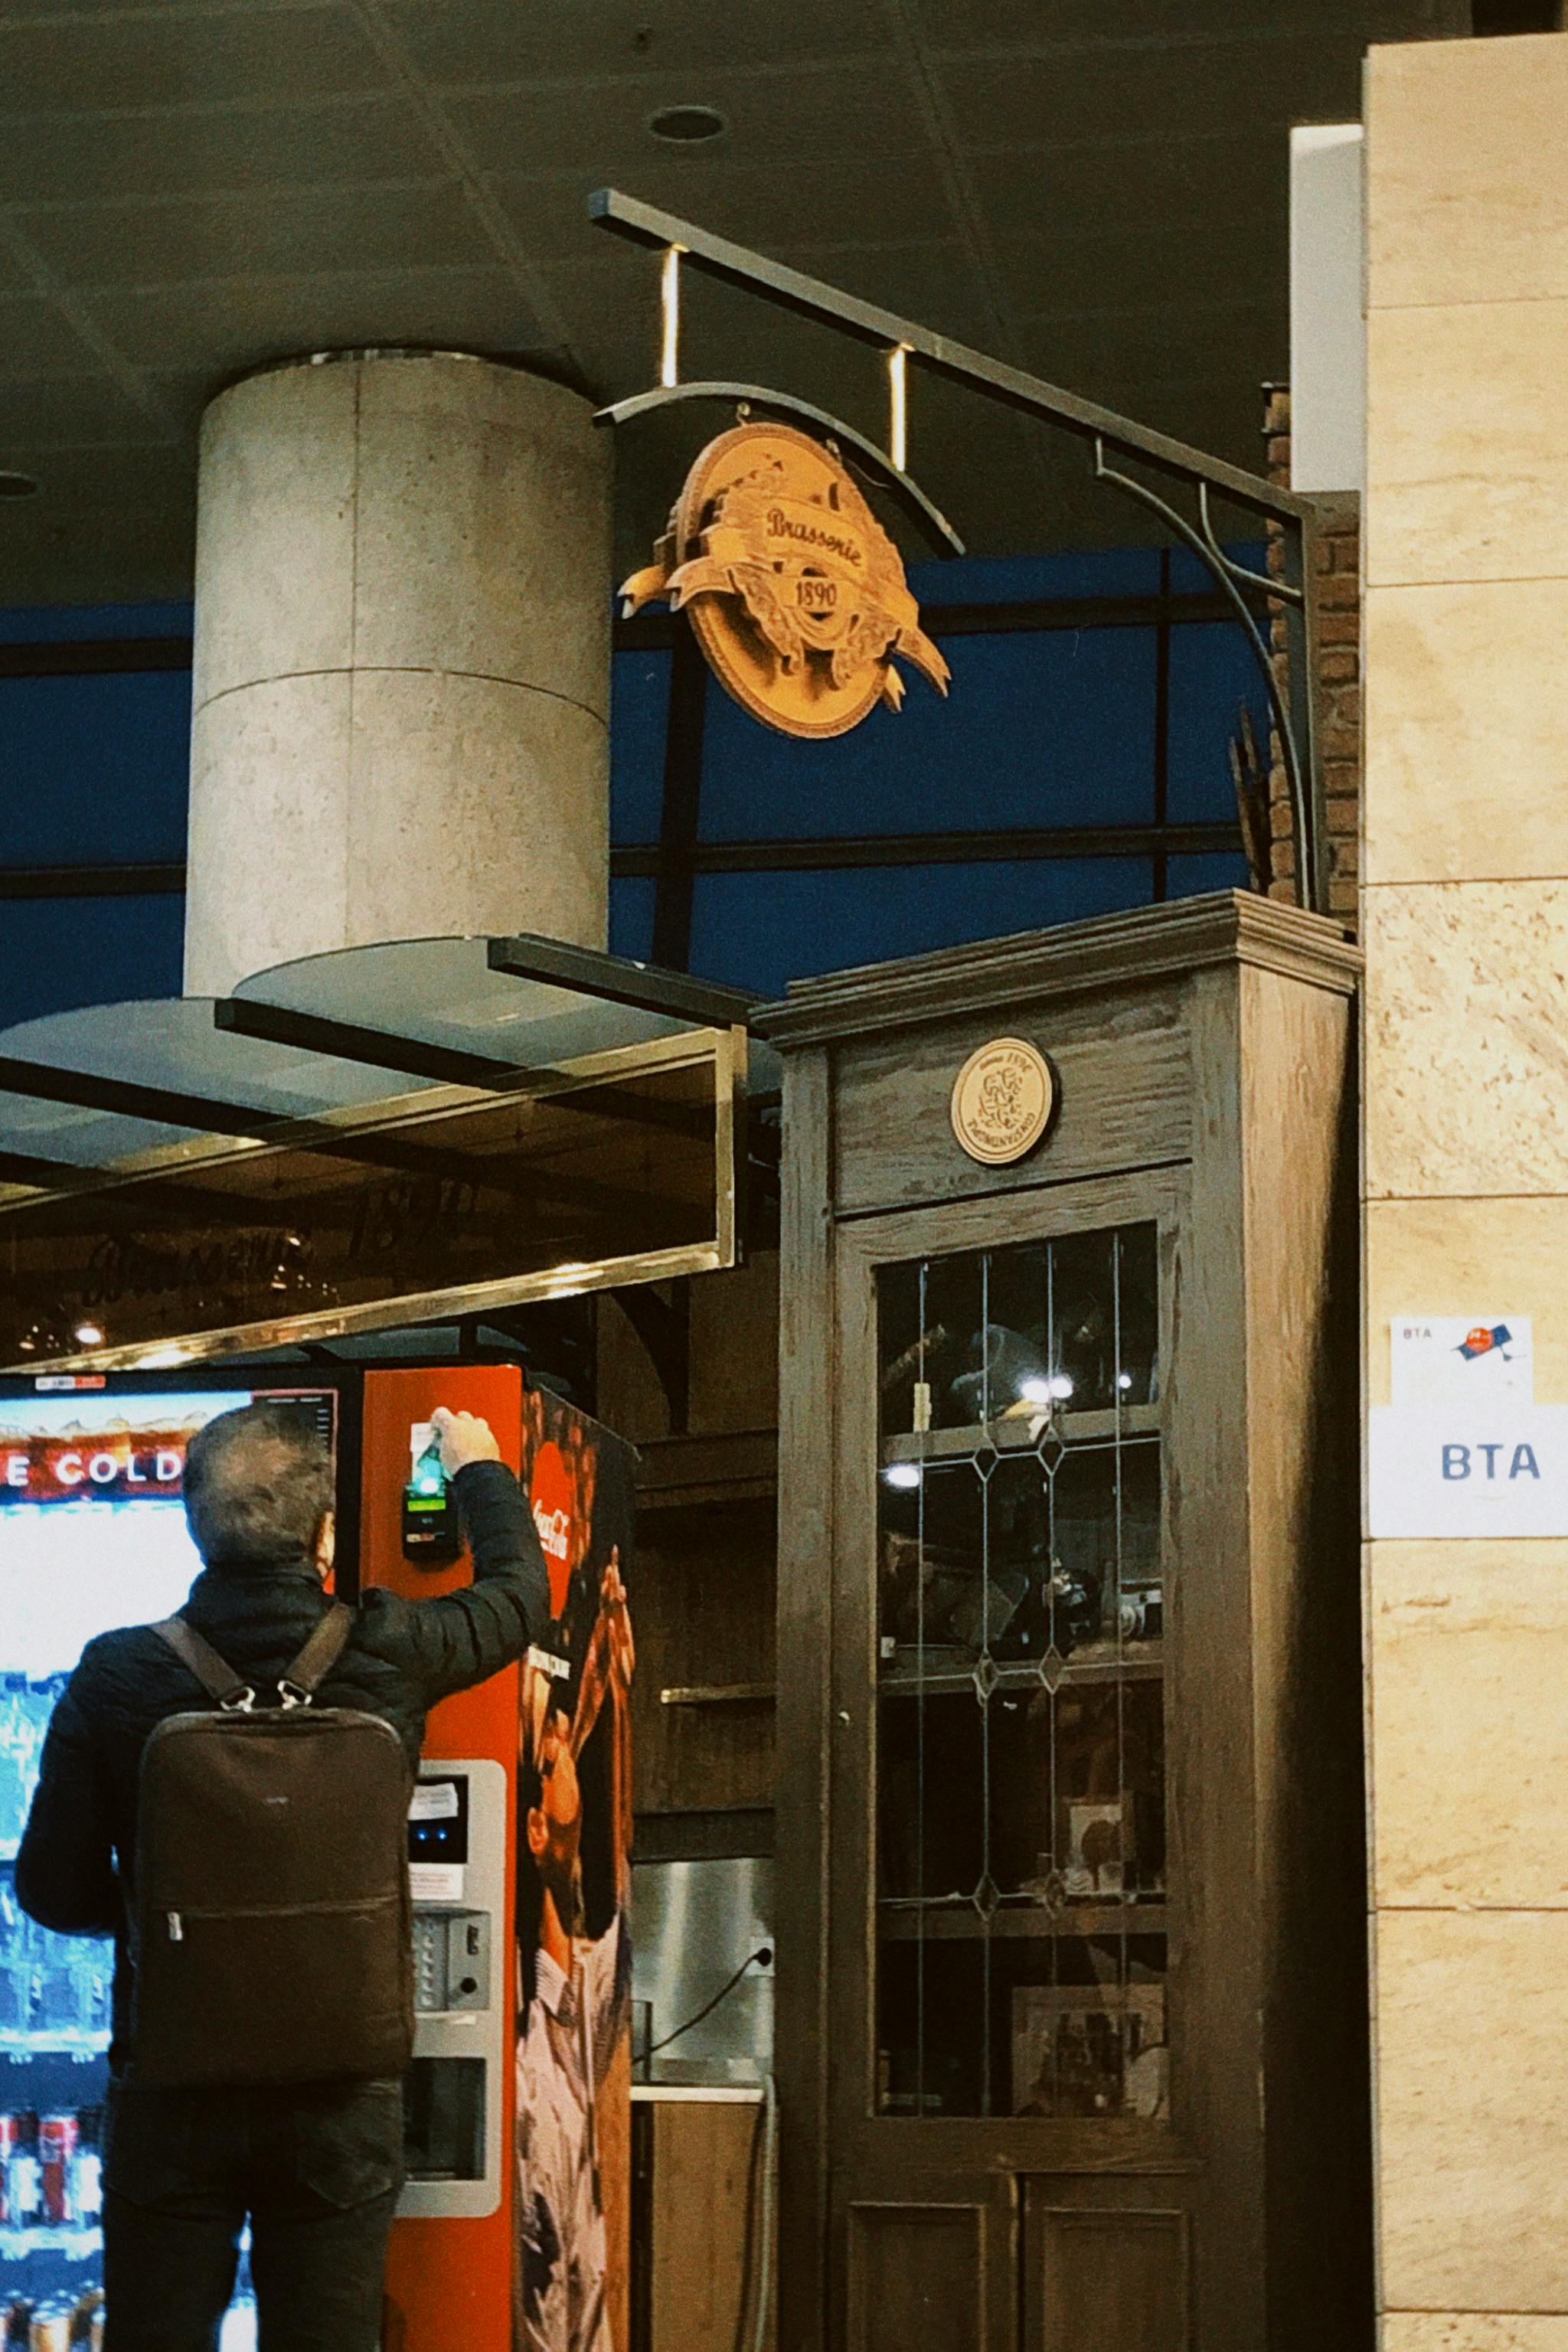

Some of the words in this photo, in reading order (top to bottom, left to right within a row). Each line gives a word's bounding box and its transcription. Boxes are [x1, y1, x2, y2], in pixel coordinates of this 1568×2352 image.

[766, 508, 861, 567] Brasserie
[796, 581, 838, 606] 1890
[1403, 1328, 1432, 1339] BTA
[55, 1452, 182, 1485] COLD
[1442, 1442, 1540, 1481] BTA
